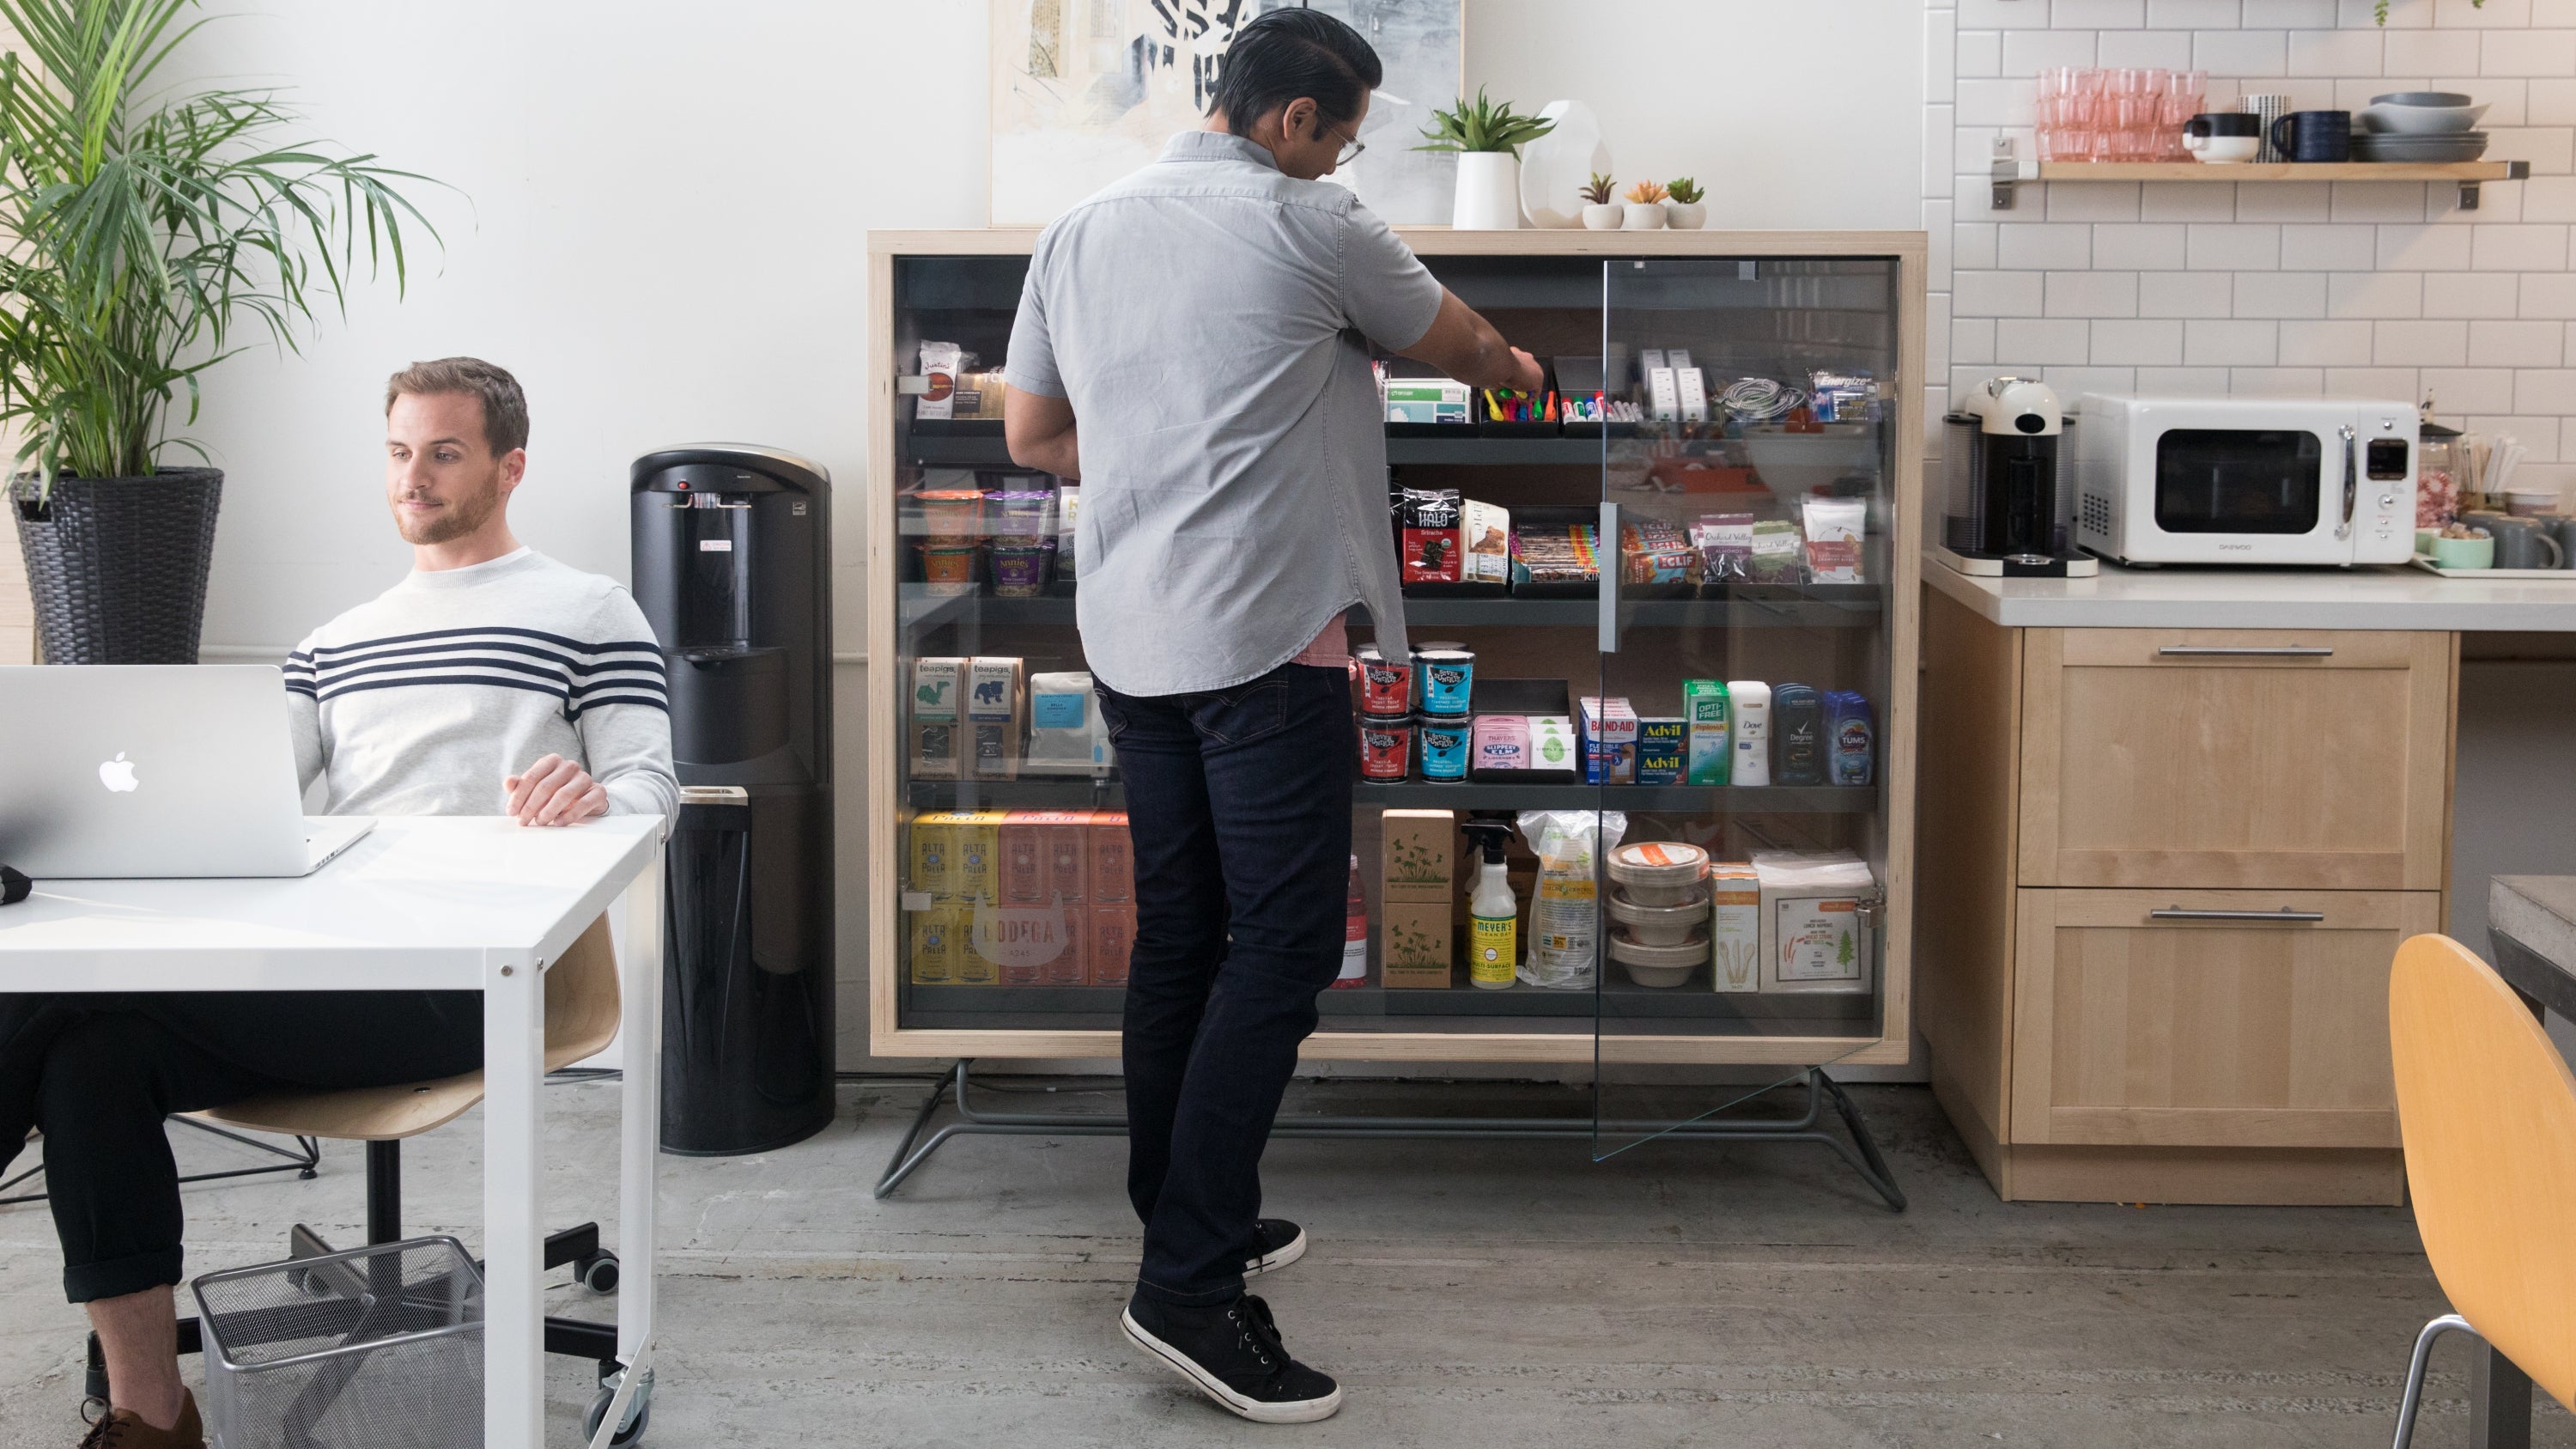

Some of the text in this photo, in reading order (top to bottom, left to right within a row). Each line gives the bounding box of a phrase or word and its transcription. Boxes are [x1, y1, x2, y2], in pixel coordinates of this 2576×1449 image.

[1820, 376, 1872, 387] Energizer
[1419, 512, 1448, 527] HALO
[1705, 533, 1753, 543] Orchard Valley
[999, 557, 1029, 568] Annie's
[1668, 556, 1693, 567] CLIF
[1584, 573, 1600, 581] KIN
[1698, 703, 1722, 713] OPTI-
[1698, 709, 1722, 719] FREE
[1591, 721, 1635, 732] BAND-AID
[1644, 725, 1681, 736] Advil
[1743, 721, 1762, 729] Dove
[1789, 734, 1814, 742] Degree
[1642, 757, 1680, 768] Advil
[921, 843, 945, 856] ALTA
[963, 843, 986, 856] ALTA
[1478, 922, 1511, 932] MEYER'S
